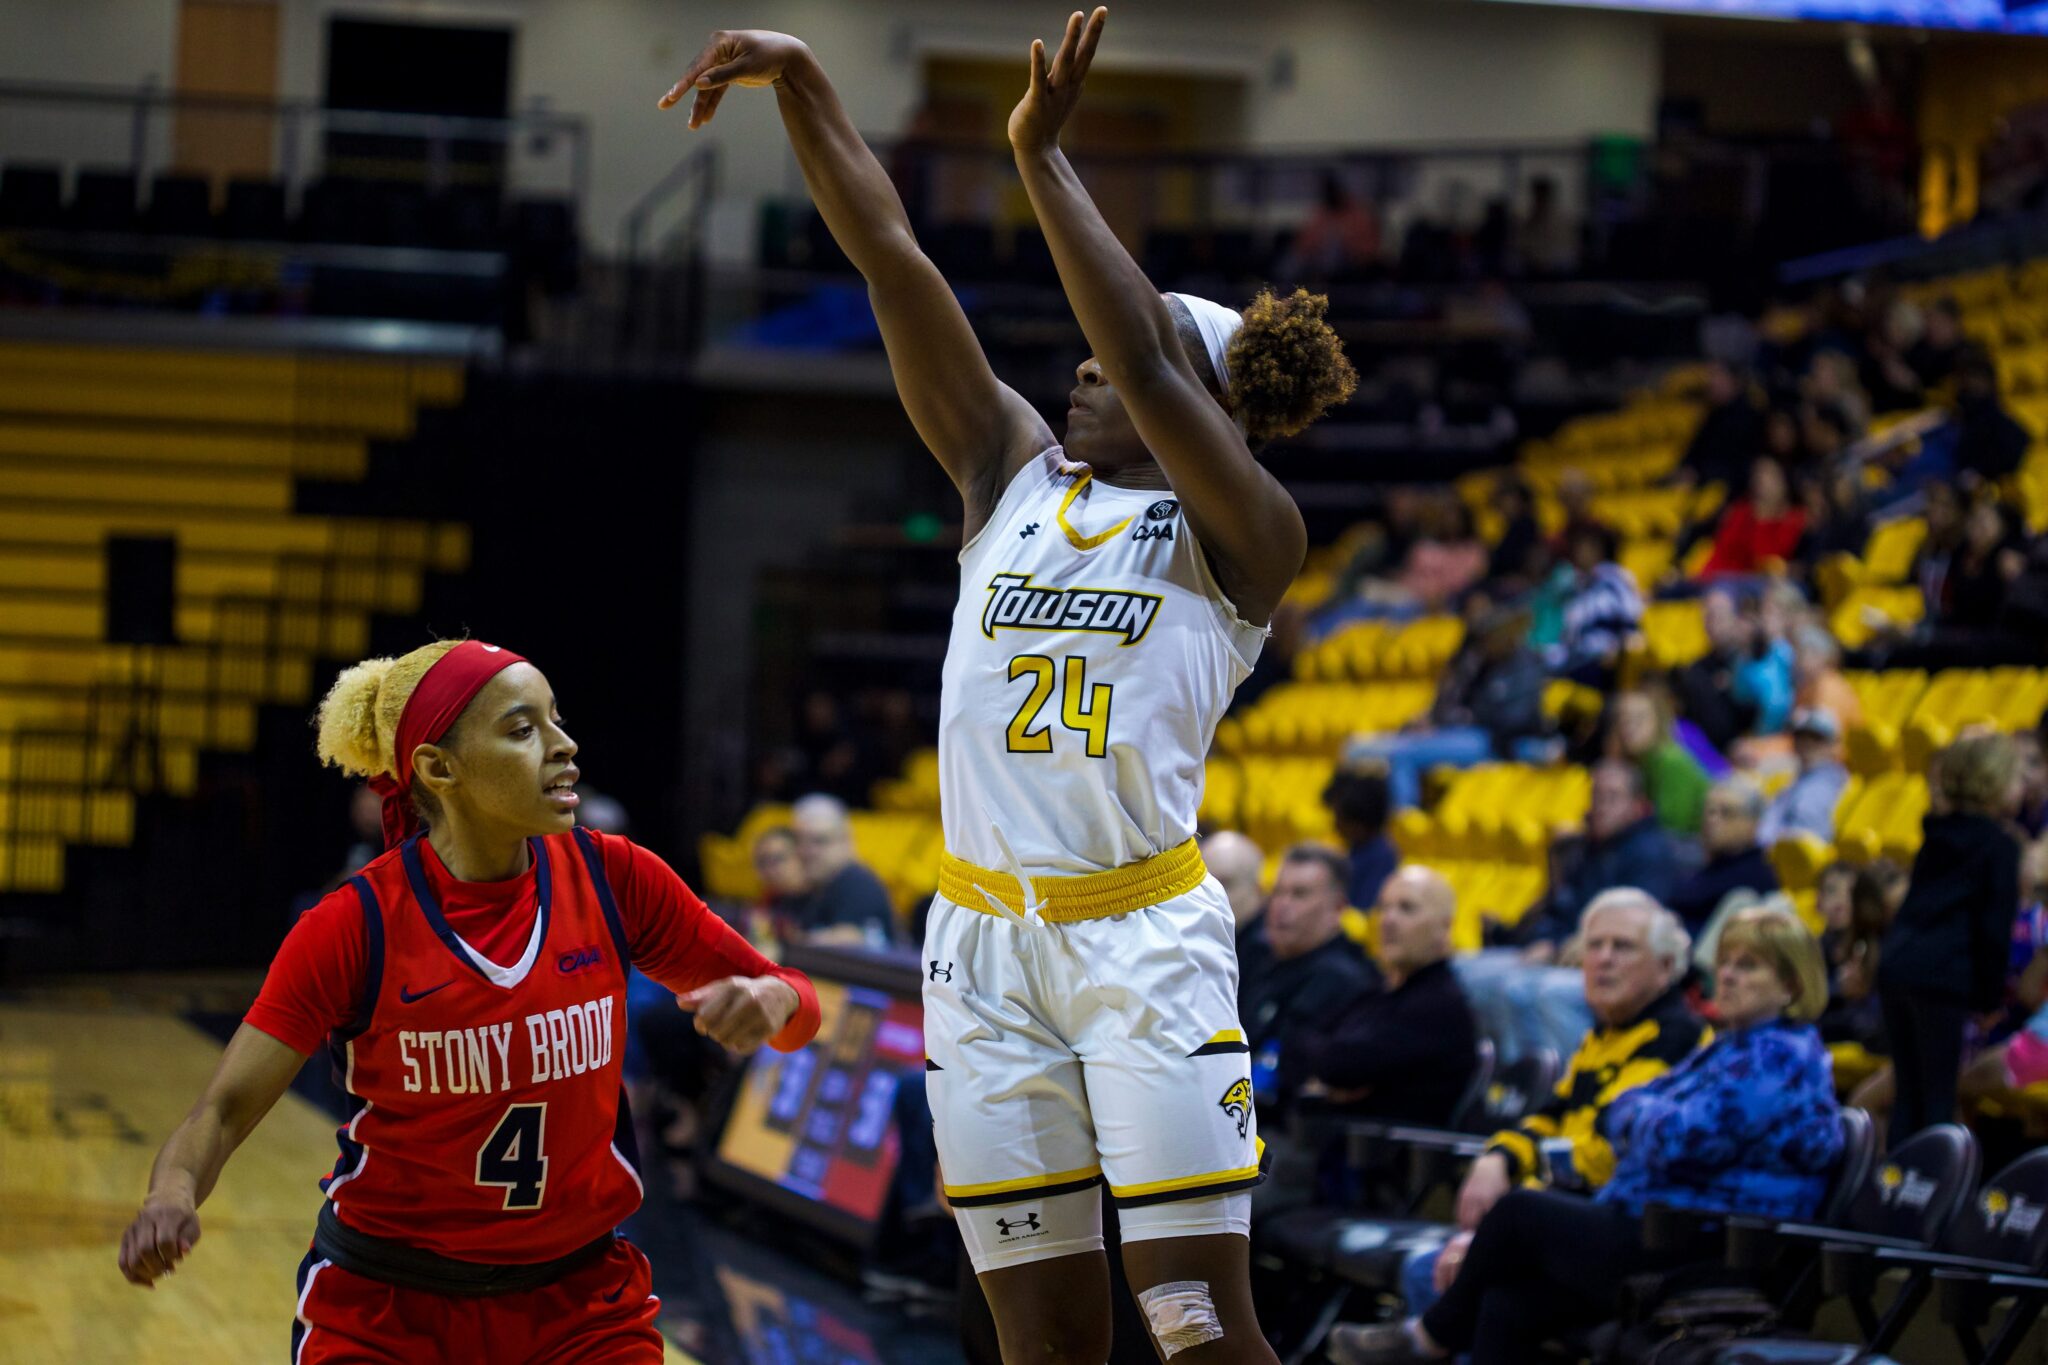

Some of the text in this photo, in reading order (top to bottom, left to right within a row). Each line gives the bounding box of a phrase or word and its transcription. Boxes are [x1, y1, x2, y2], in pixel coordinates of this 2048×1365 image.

[1132, 523, 1174, 541] CAA
[981, 572, 1165, 647] TOWSON
[1005, 654, 1113, 758] 24
[558, 947, 601, 973] CAA
[399, 996, 613, 1094] STONY BROOK
[475, 1102, 548, 1210] 4
[998, 1230, 1049, 1244] UNDER ARMOUR
